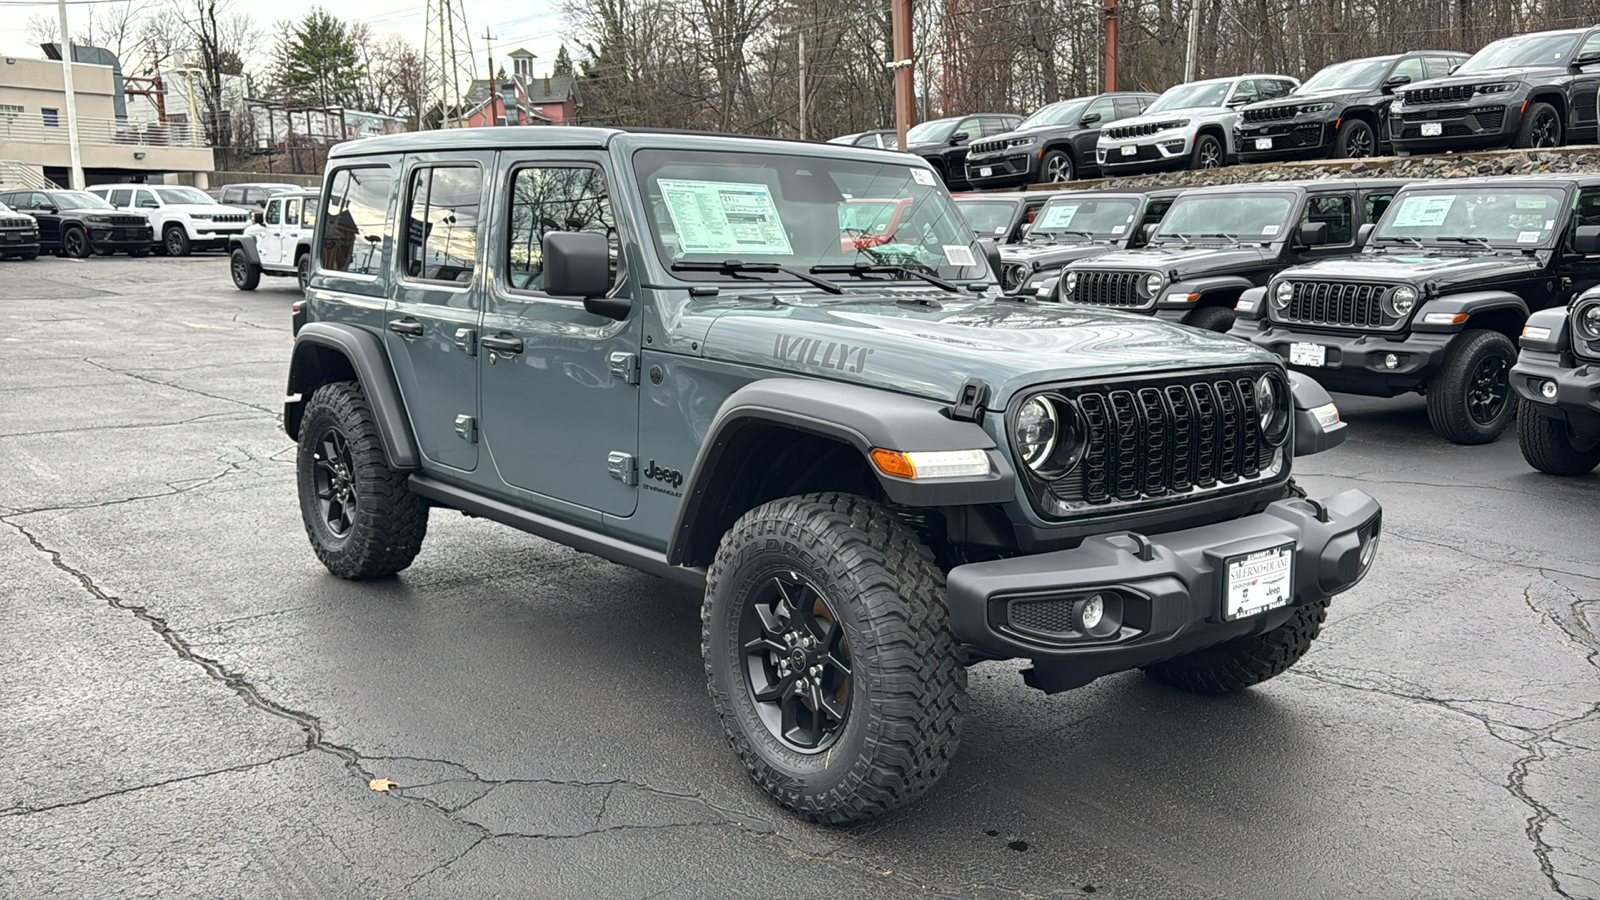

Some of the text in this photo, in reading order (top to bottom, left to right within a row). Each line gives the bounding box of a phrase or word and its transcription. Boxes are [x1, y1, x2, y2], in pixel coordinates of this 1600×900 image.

[773, 333, 875, 374] WILLYS
[643, 459, 683, 489] Jeep
[732, 538, 847, 604] WILDPEAK
[1266, 586, 1281, 596] Jeep
